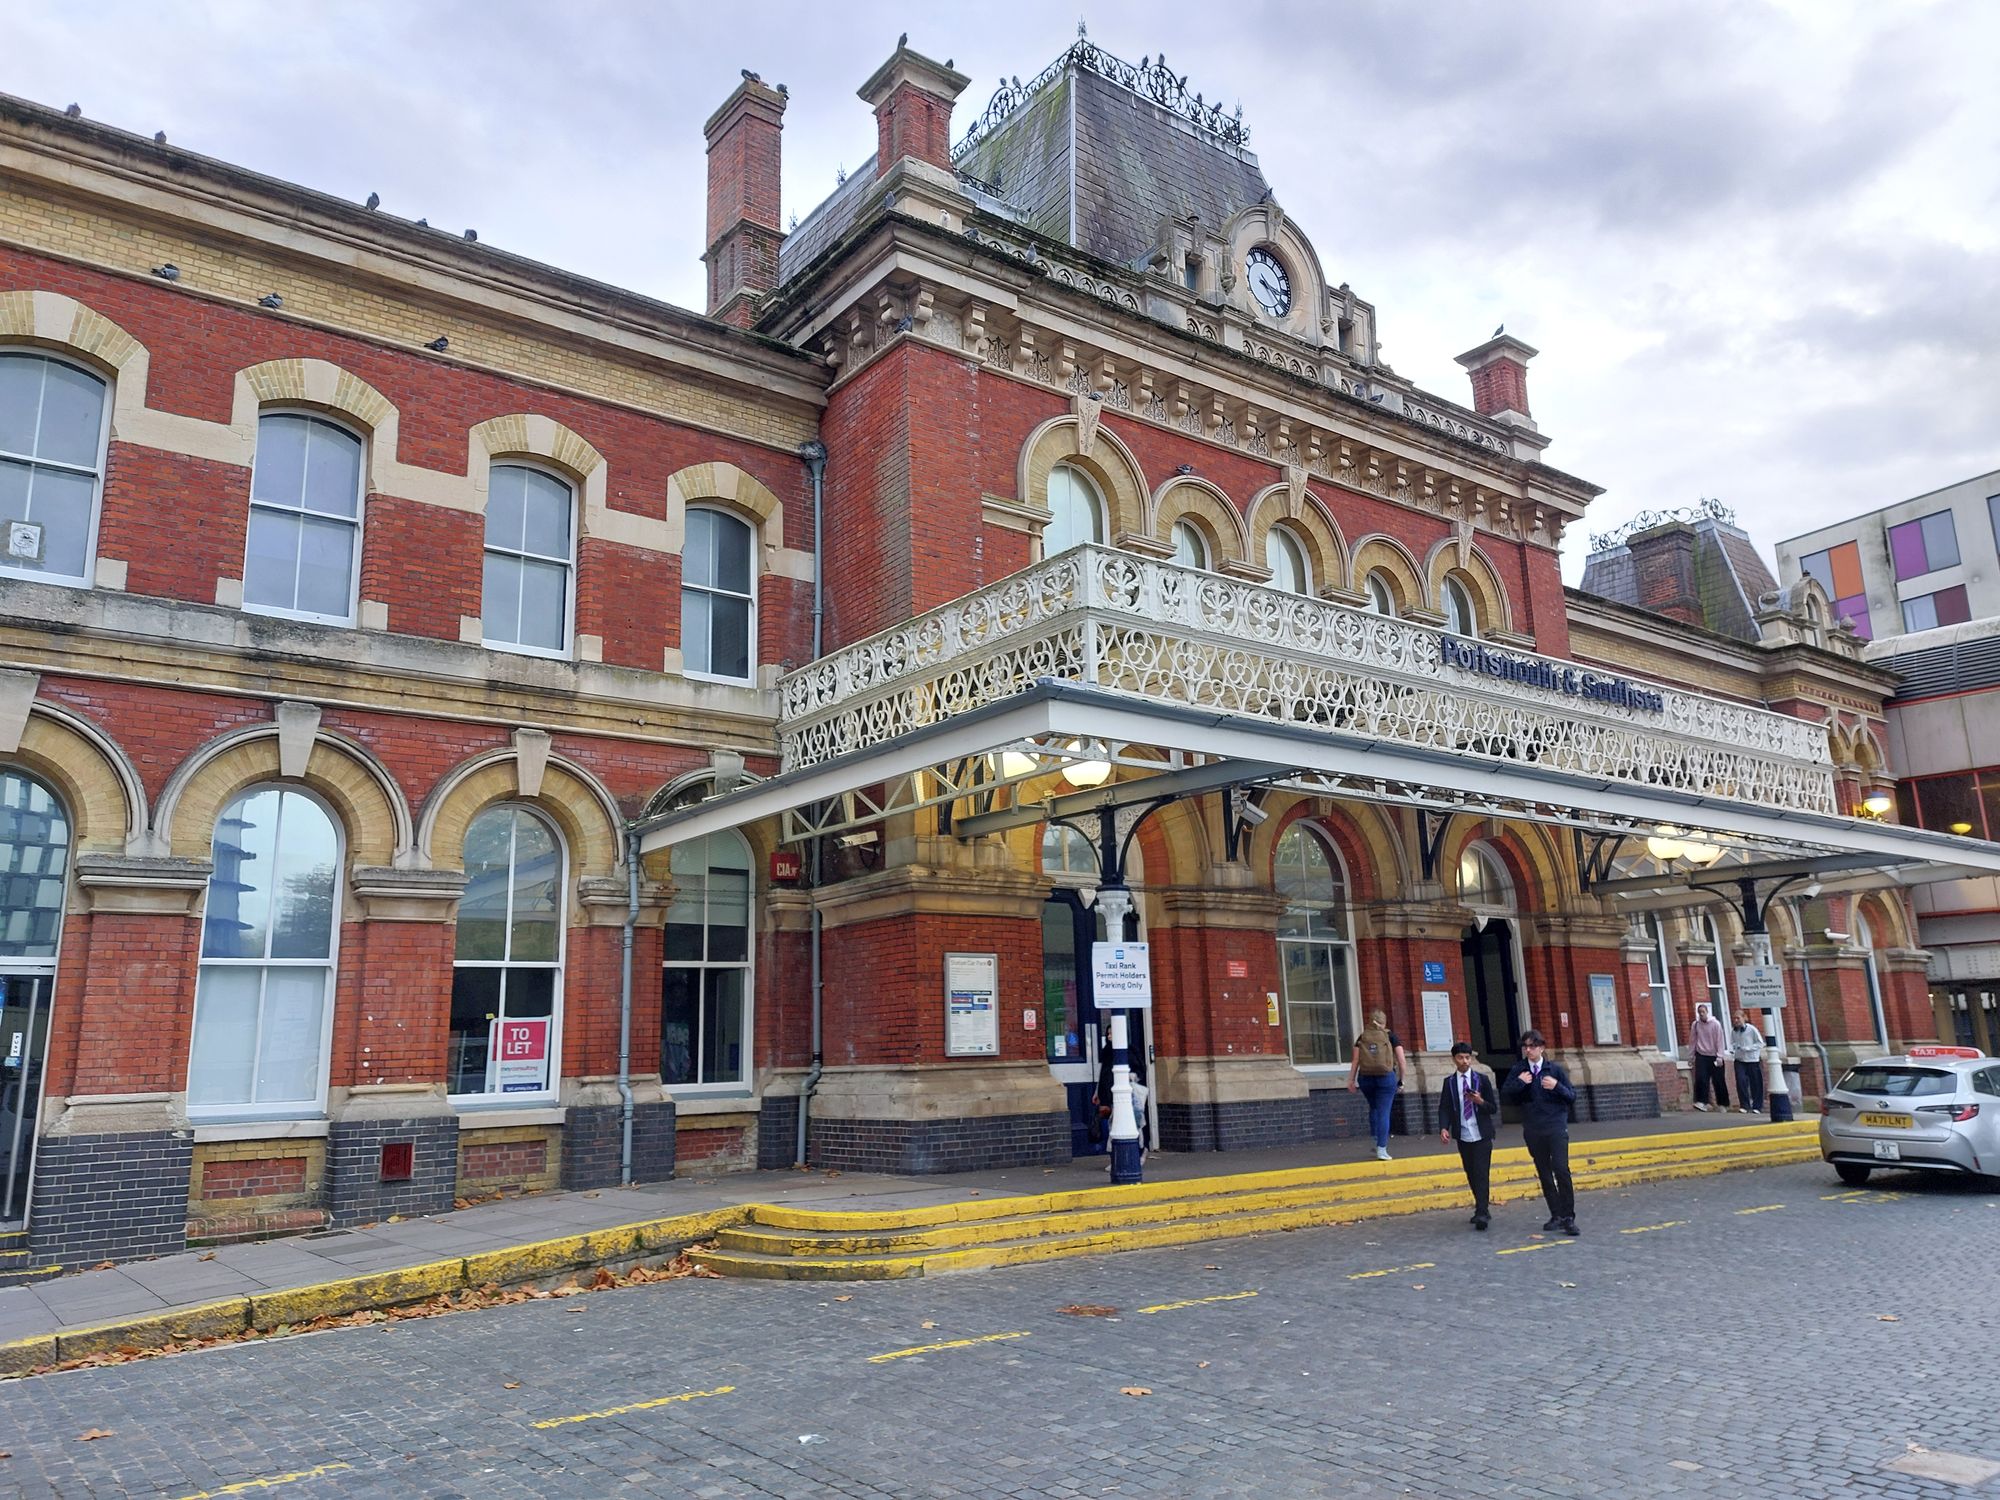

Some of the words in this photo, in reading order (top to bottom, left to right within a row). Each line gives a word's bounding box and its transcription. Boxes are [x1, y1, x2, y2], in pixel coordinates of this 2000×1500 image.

[1441, 636, 1559, 690] Portsmouth
[1563, 669, 1578, 695] &
[1582, 674, 1664, 712] Southsea
[1100, 982, 1126, 990] Parking
[1127, 982, 1143, 990] Only
[510, 1027, 530, 1041] TO
[506, 1042, 532, 1055] LET
[1914, 1048, 1936, 1056] TAXI
